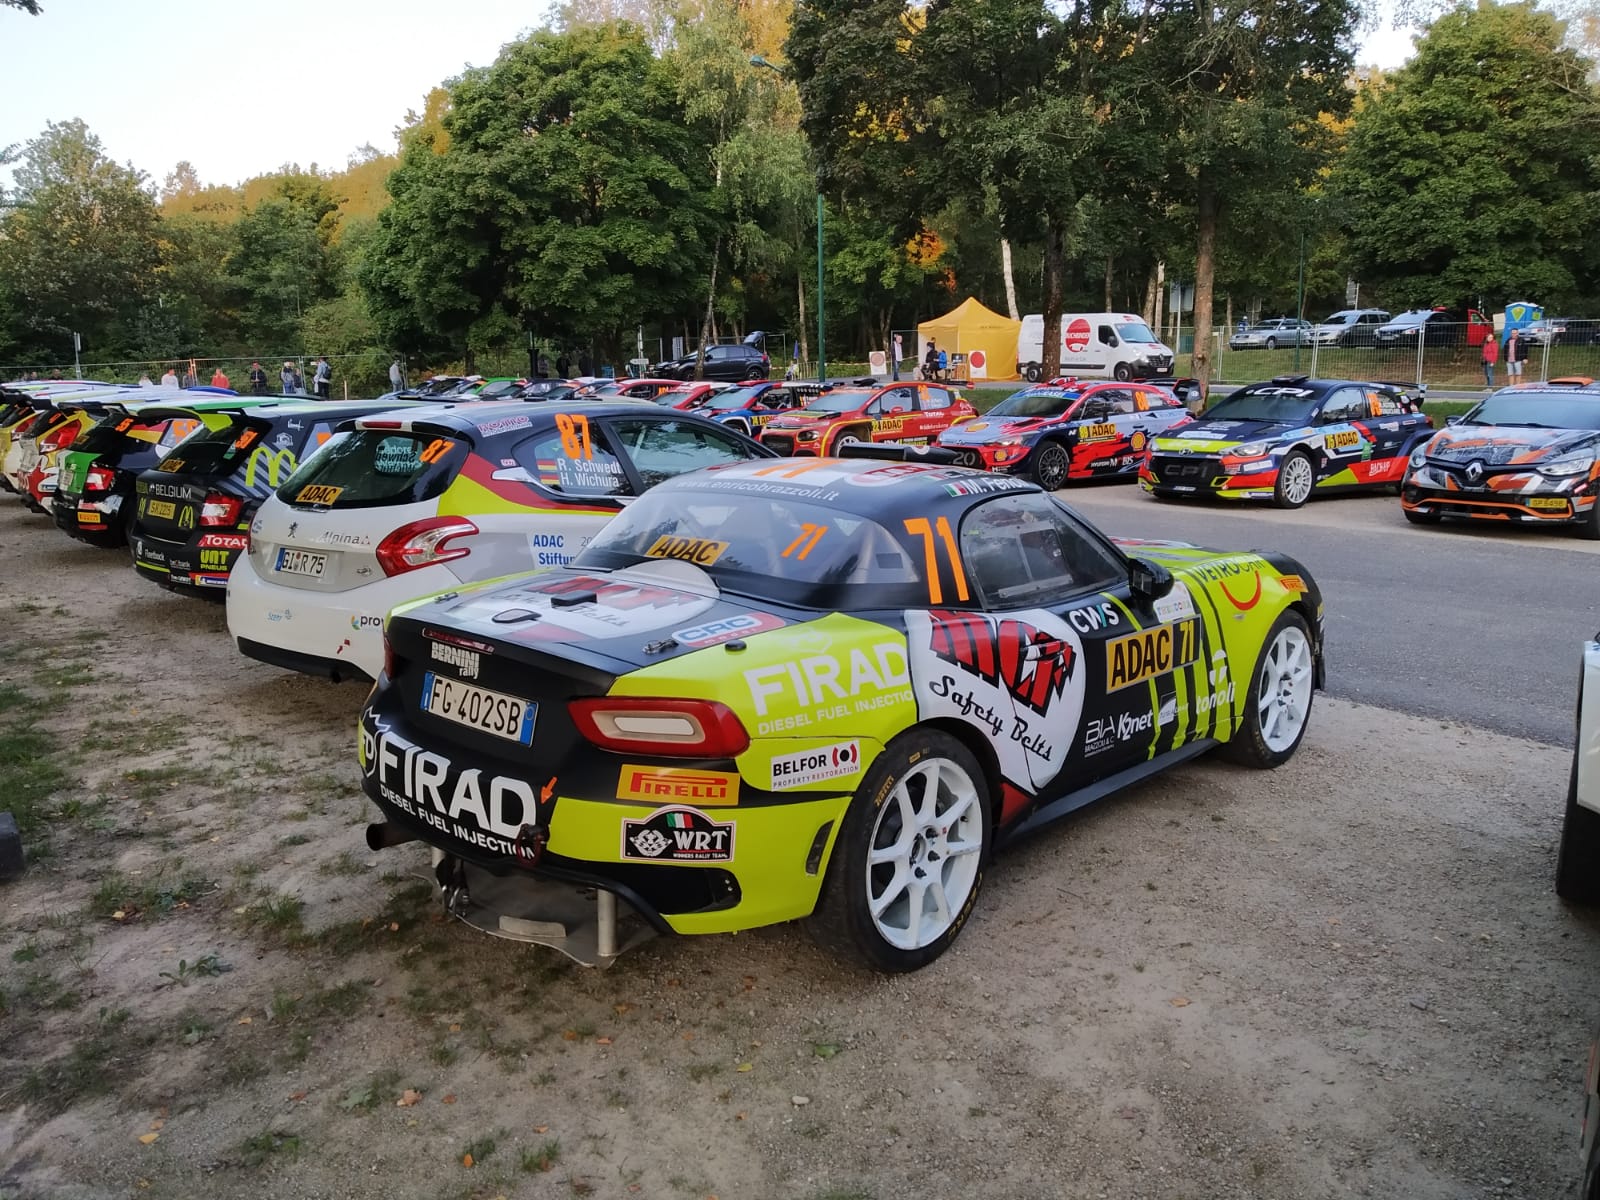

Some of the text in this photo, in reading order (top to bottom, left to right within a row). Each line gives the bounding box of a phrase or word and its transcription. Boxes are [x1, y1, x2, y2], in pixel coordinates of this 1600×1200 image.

[554, 413, 593, 461] 87
[882, 419, 903, 431] ADAC
[1091, 423, 1116, 437] ADAC
[419, 438, 456, 464] 87
[1337, 431, 1359, 447] ADAC
[557, 457, 622, 475] R. Schwedt
[1164, 463, 1209, 478] CPI
[155, 484, 192, 499] BELGIUM
[560, 473, 620, 488] H. Wichura
[677, 480, 840, 501] www.enricobrazzoli.it
[960, 479, 988, 495] M.
[301, 486, 338, 501] ADAC
[321, 530, 360, 545] Alpina
[533, 534, 564, 548] ADAC
[652, 537, 720, 563] ADAC
[781, 523, 829, 560] 71
[281, 551, 326, 574] GI R 75
[903, 516, 970, 605] 71
[678, 617, 755, 641] CRC
[431, 641, 480, 668] BERNINI
[1111, 619, 1196, 689] ADAC 71
[459, 666, 480, 680] rally
[742, 641, 908, 717] FIRAD
[431, 678, 520, 735] FG 402SB
[929, 675, 1052, 762] Safety Belts
[758, 712, 813, 736] DIESEL
[816, 704, 851, 722] FUEL
[1117, 709, 1154, 741] K2net
[772, 753, 828, 778] BELFOR
[773, 764, 860, 789] PROPERTY RESTORATION
[379, 731, 537, 840] FIRAD
[630, 772, 729, 798] PIRELLI
[379, 784, 417, 817] DIESEL
[418, 807, 451, 834] FUEL
[673, 830, 729, 850] WRT
